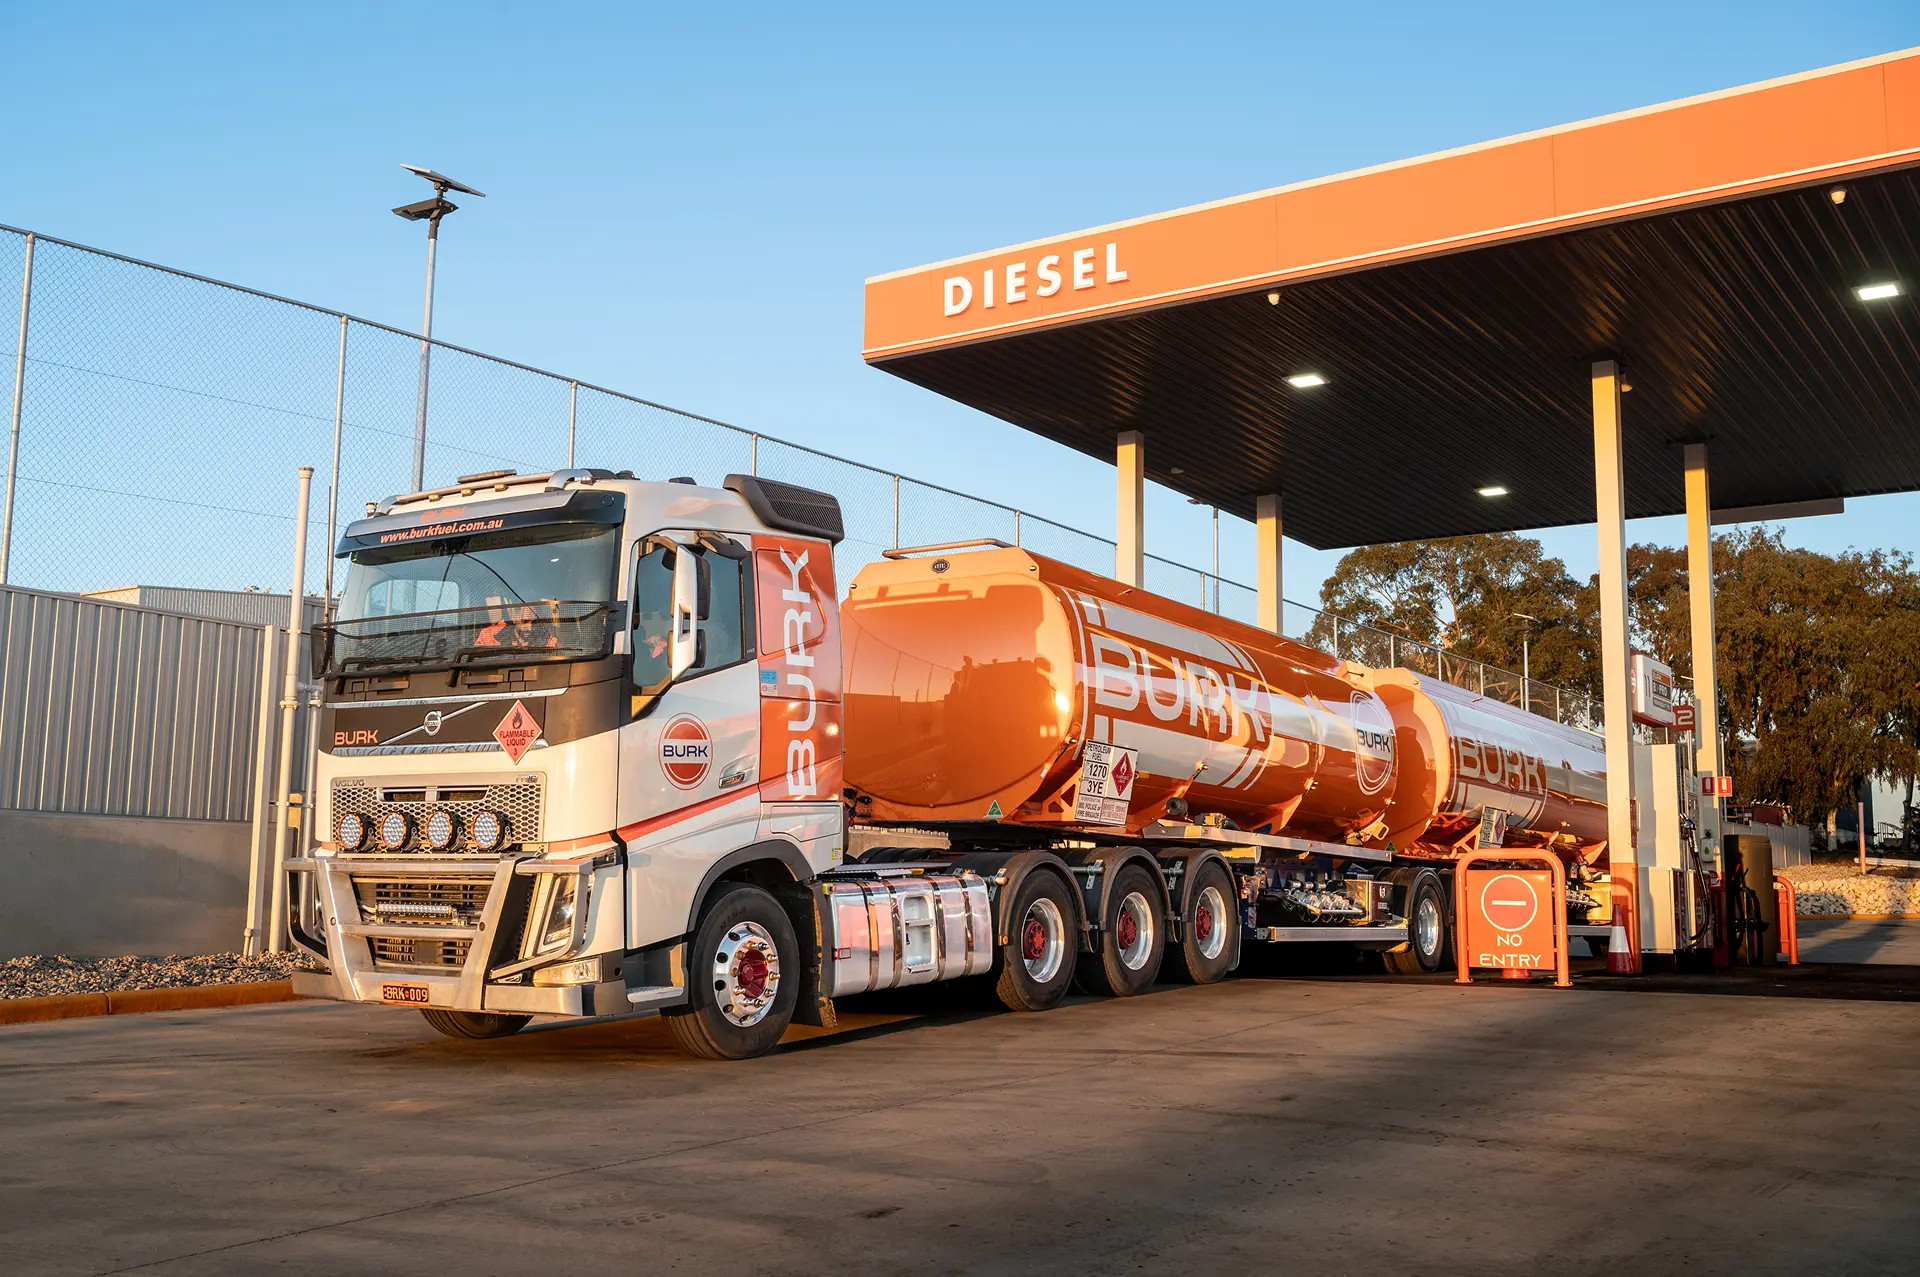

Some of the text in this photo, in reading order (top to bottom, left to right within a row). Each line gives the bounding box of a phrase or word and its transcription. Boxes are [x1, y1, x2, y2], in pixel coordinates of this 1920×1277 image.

[944, 242, 1128, 317] DIESEL
[380, 519, 503, 544] www.burkfuel.com.au
[780, 545, 817, 796] BURK
[1090, 633, 1265, 742] BURK
[334, 729, 379, 746] BURK
[499, 729, 535, 739] FLAMMABLE
[1356, 728, 1391, 753] BURK
[506, 738, 526, 747] LIQUID
[513, 748, 518, 756] 3
[663, 745, 709, 758] BURK
[1456, 729, 1543, 795] BURK
[1089, 764, 1107, 778] 1270
[1087, 780, 1104, 794] 3YE
[1496, 933, 1522, 947] NO
[1479, 953, 1542, 968] ENTRY
[386, 987, 428, 1001] BRK 009
